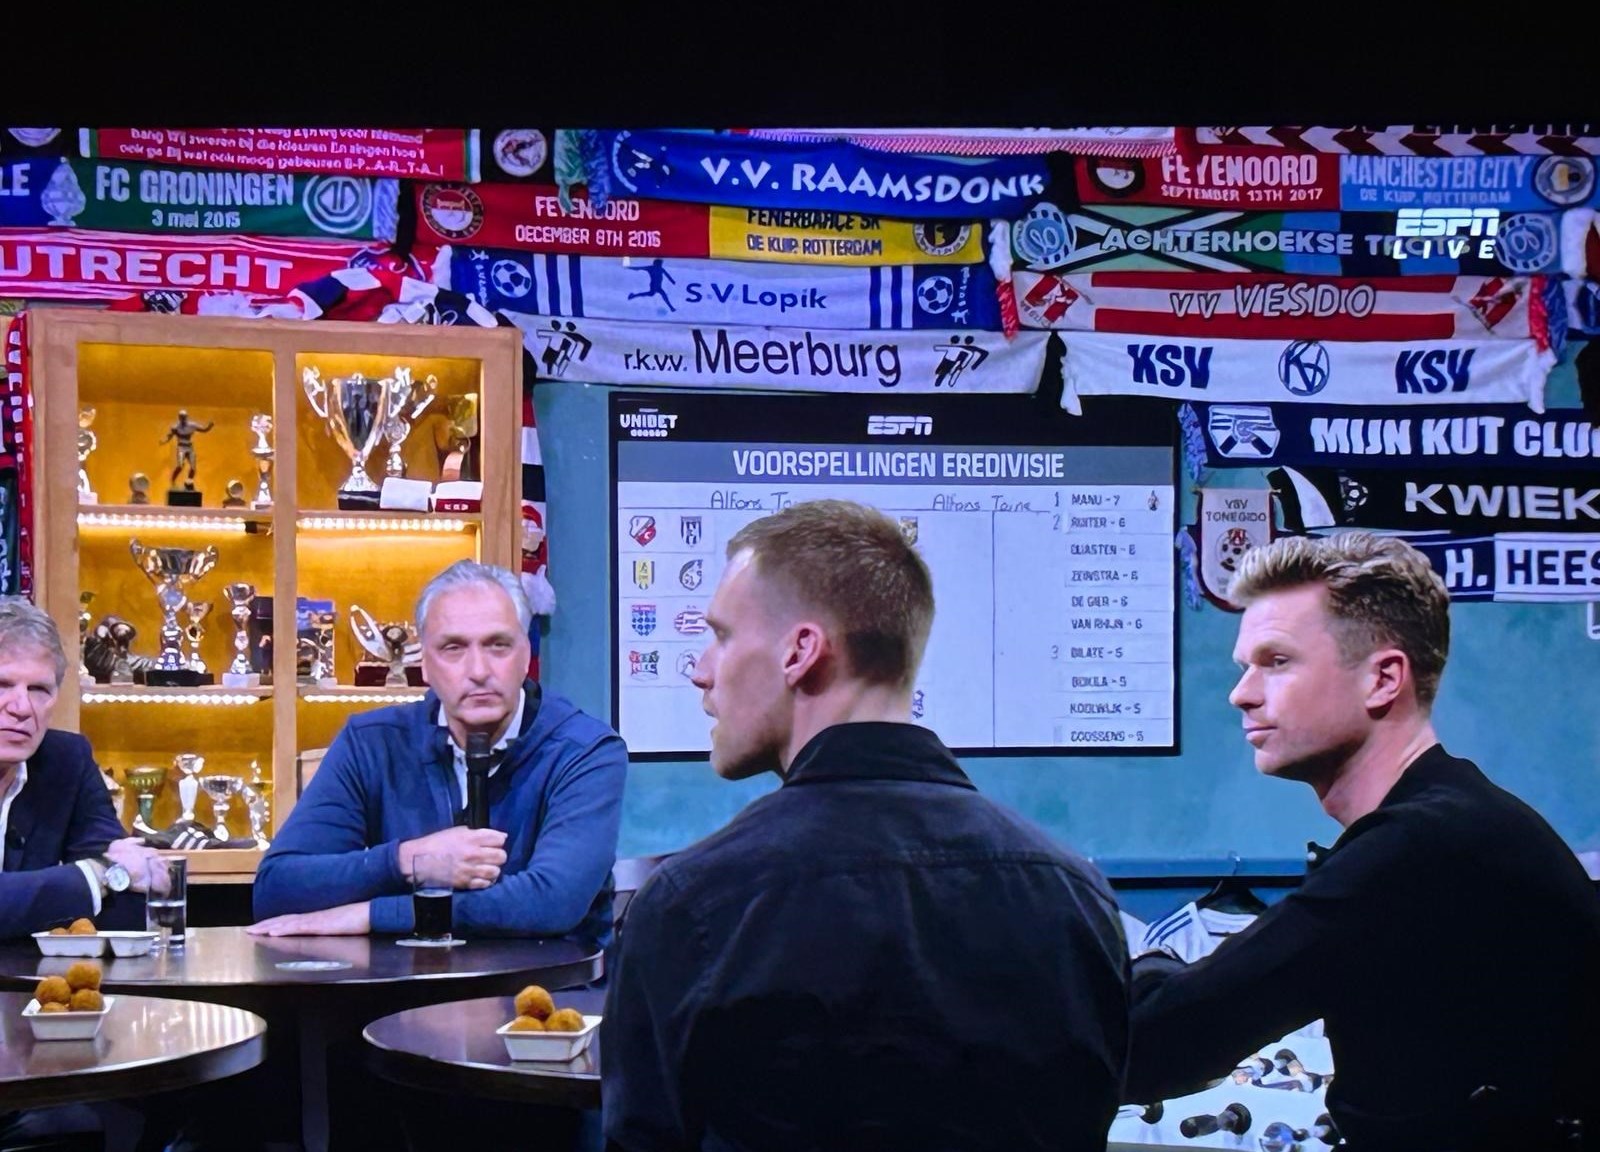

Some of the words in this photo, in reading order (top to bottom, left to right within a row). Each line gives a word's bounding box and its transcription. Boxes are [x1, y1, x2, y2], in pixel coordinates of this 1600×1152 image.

[96, 165, 130, 202] FC
[140, 169, 294, 207] GRONINGEN
[700, 157, 780, 190] V.V.
[792, 162, 1045, 205] RAAMSDONK
[1342, 155, 1475, 189] MANCHESTER
[1479, 156, 1532, 189] CITY
[1161, 184, 1241, 202] SEPTEMBER
[1247, 190, 1283, 203] 13TH
[1289, 187, 1324, 202] 2017
[152, 209, 163, 227] 3
[515, 224, 590, 245] DECEMBER
[628, 230, 662, 248] 2016
[746, 233, 764, 251] DE
[803, 238, 883, 256] ROTTERDAM
[1102, 228, 1353, 255] ACHTERHOEKSE
[0, 243, 294, 291] UTRECHT
[742, 283, 828, 313] Lopik
[692, 328, 901, 388] Meerburg
[1127, 343, 1214, 390] KSV
[1395, 347, 1477, 394] KSV
[619, 413, 679, 429] UNIBET
[867, 415, 933, 436] ESPN
[1310, 417, 1411, 456] MIJN
[1422, 416, 1505, 456] KUT
[733, 449, 937, 478] VOORSPELLINGEN
[943, 452, 1066, 479] EREDIVISIE
[1405, 481, 1600, 520] KWIEK
[1445, 547, 1489, 588] H.
